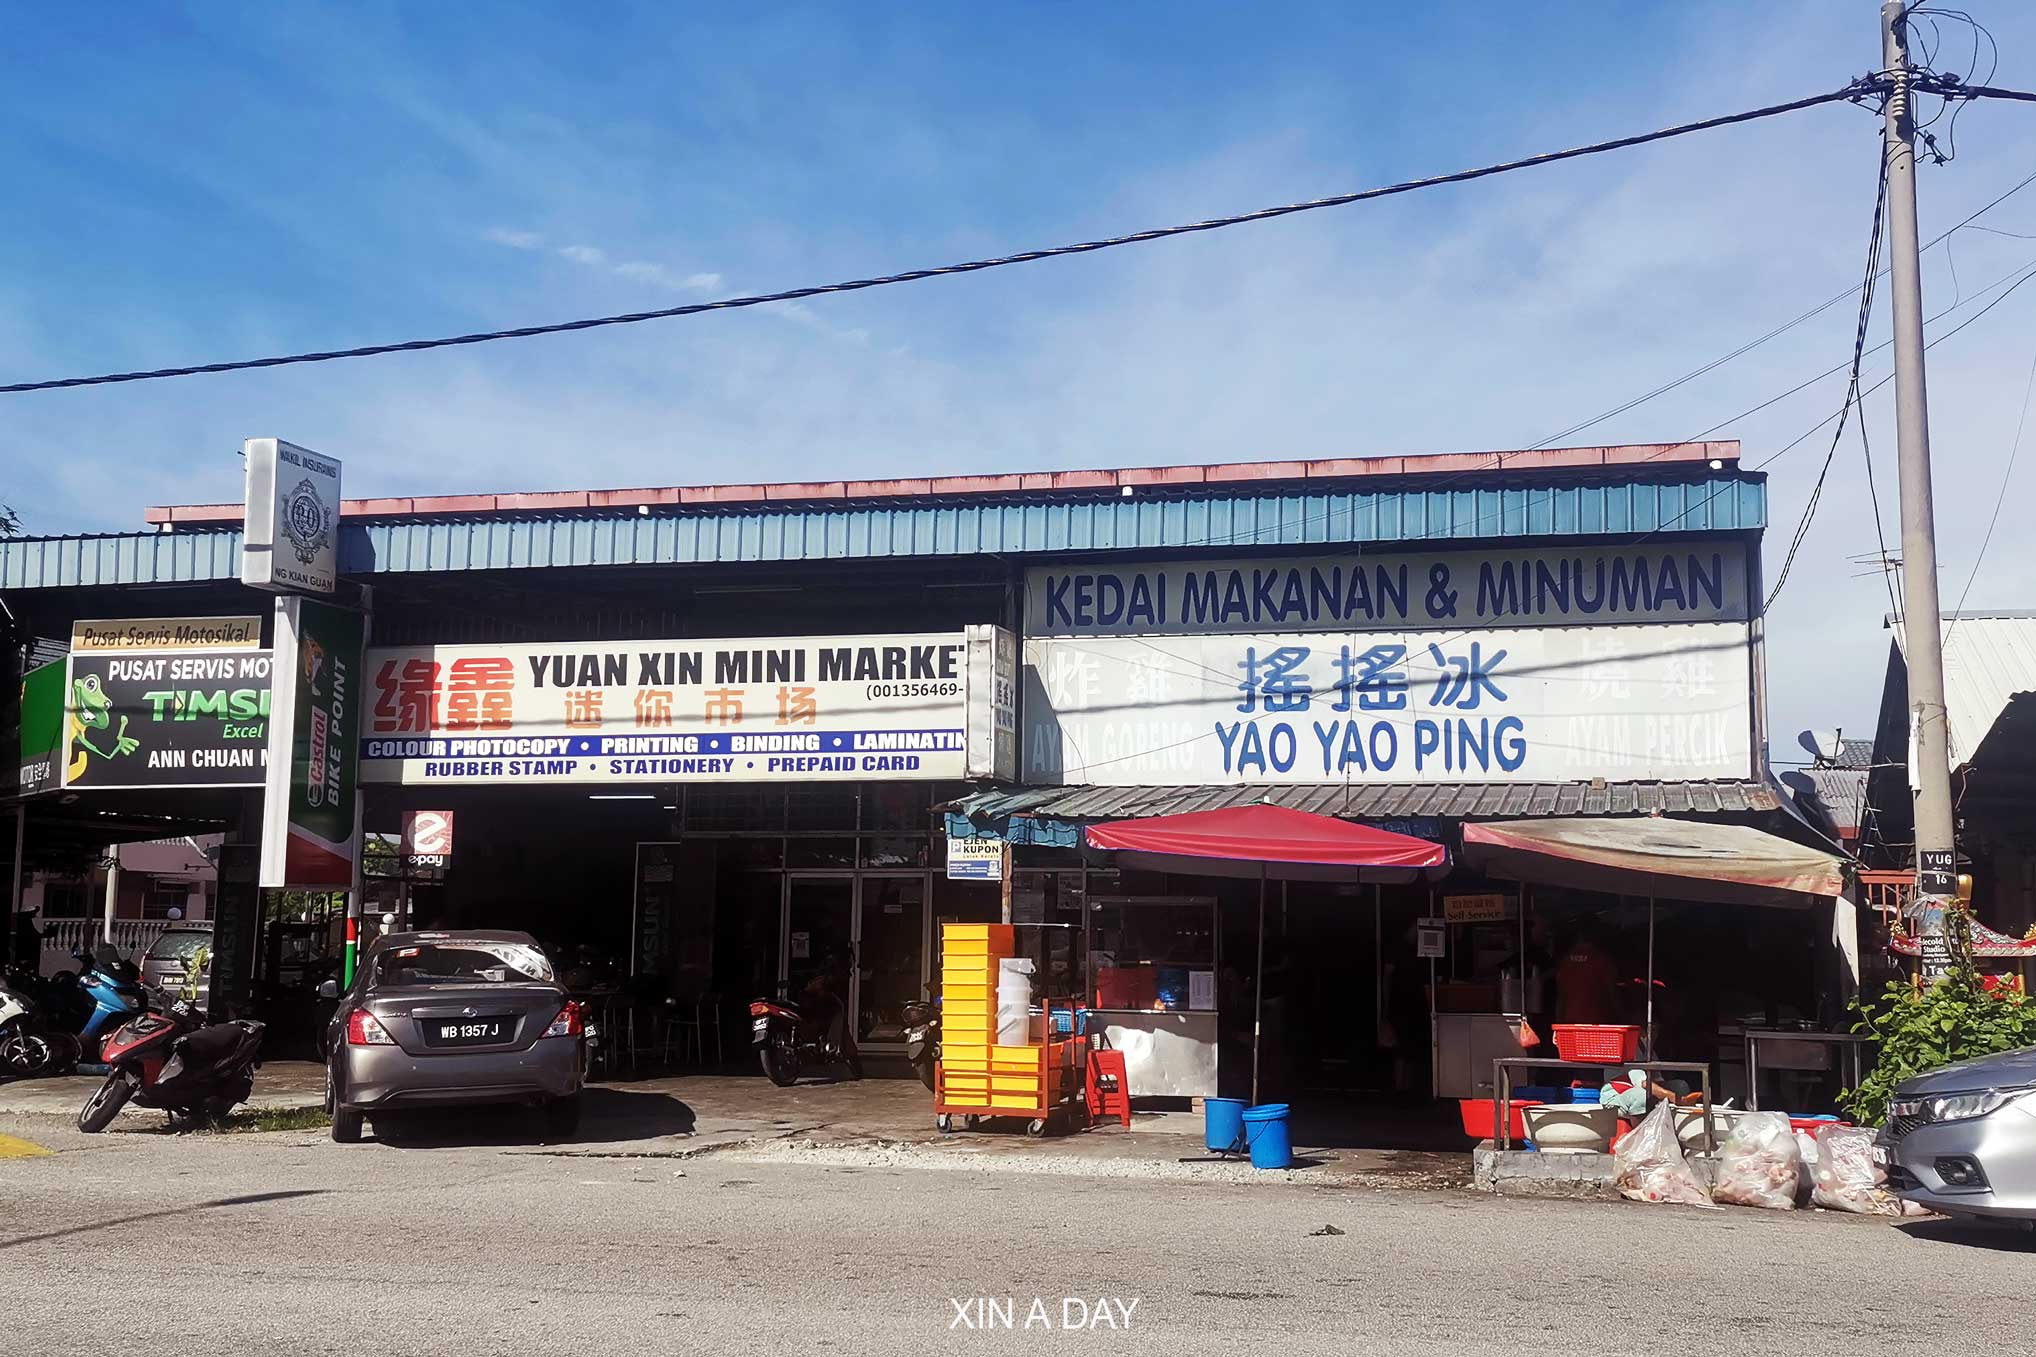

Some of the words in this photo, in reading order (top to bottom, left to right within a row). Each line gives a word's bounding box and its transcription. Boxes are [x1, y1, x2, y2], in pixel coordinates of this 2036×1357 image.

[275, 567, 288, 579] NG
[1046, 572, 1166, 628] KEDAI
[1181, 563, 1408, 624] MAKANAN
[1424, 562, 1458, 619] &
[1476, 552, 1723, 617] MINUMAN
[83, 627, 126, 647] Pusat
[126, 625, 171, 646] Servis
[174, 622, 251, 645] Motosikal
[108, 659, 166, 681] PUSAT
[170, 657, 235, 680] SERVIS
[528, 654, 627, 688] YUAN
[637, 651, 702, 686] XIN
[715, 649, 806, 684] MINI
[330, 655, 346, 737] POINT
[222, 722, 263, 740] Excel
[309, 709, 327, 783] Castrol
[368, 740, 446, 757] COLOUR
[452, 738, 571, 756] PHOTOCOPY
[601, 736, 699, 754] PRINTING
[731, 734, 820, 752] BINDING
[1215, 720, 1297, 776] YAO
[1313, 719, 1398, 776] YAO
[1415, 716, 1526, 774] PING
[148, 750, 186, 768] ANN
[191, 749, 254, 767] CHUAN
[425, 760, 503, 777] RUBBER
[508, 760, 577, 775] STAMP
[610, 758, 734, 774] STATIONERY
[768, 756, 856, 772] PREPAID
[862, 755, 920, 771] CARD
[327, 745, 342, 807] BIKE
[963, 845, 999, 853] KUPON
[1926, 853, 1953, 865] YUG
[1935, 874, 1948, 885] 16
[441, 1025, 458, 1038] WB
[459, 1024, 488, 1038] 1357
[491, 1023, 499, 1036] J
